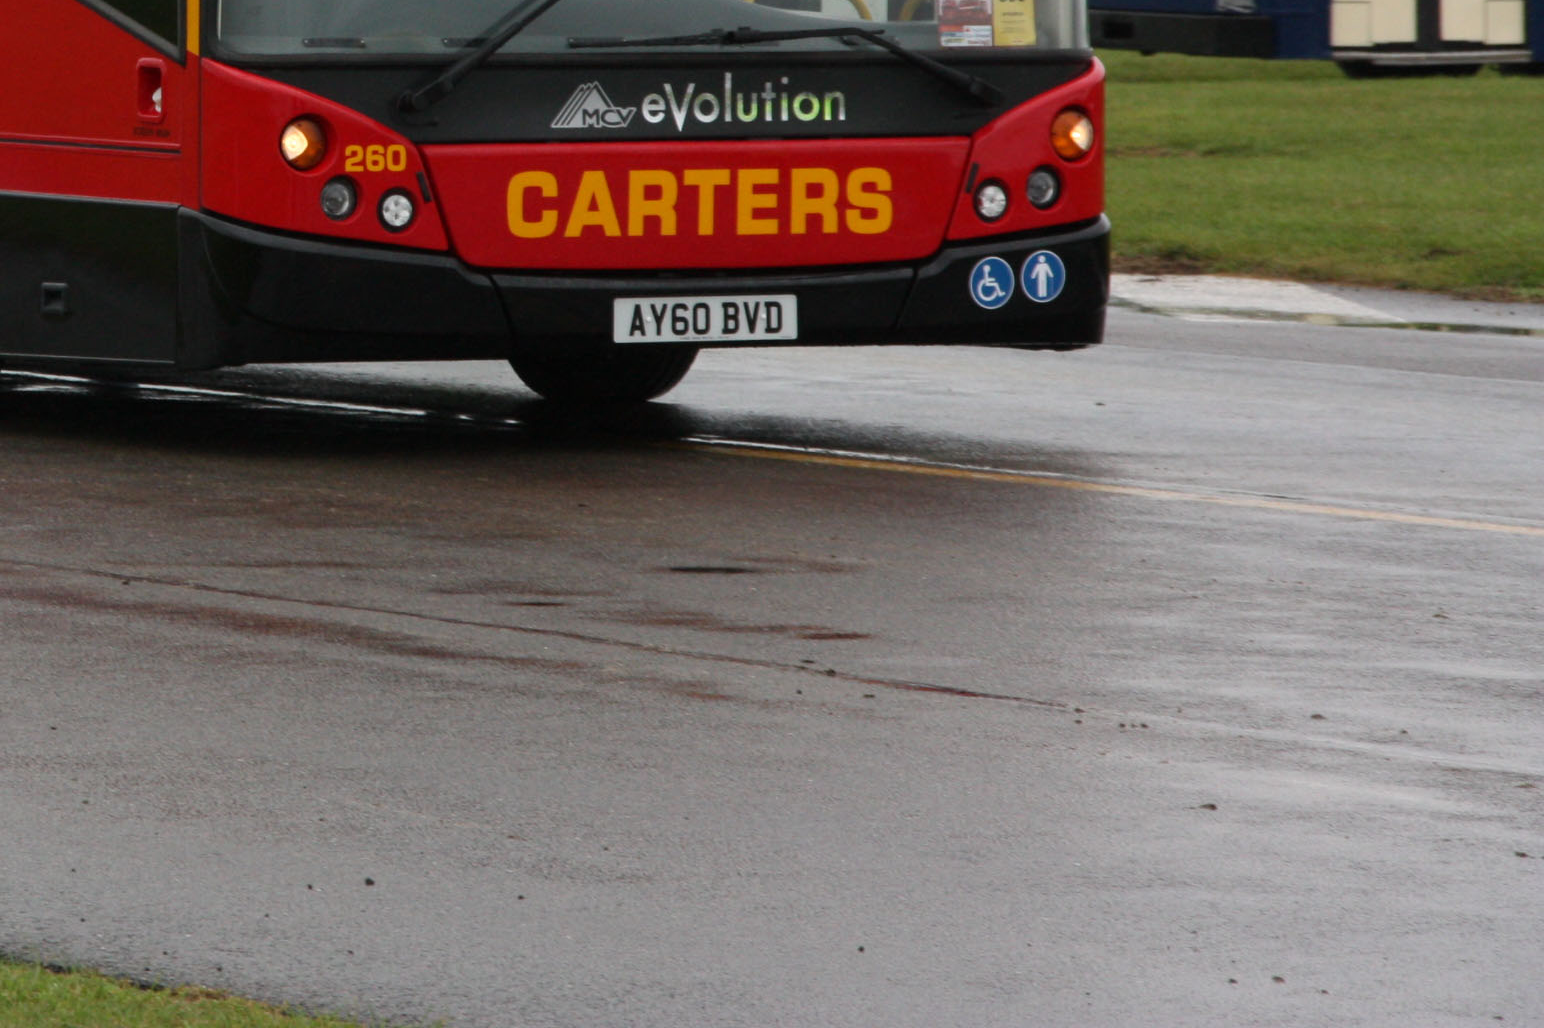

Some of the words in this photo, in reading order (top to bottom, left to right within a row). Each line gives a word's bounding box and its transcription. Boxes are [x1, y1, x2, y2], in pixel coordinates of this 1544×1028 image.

[581, 107, 637, 127] MCV
[344, 144, 407, 172] 260
[506, 167, 894, 239] CARTERS
[628, 302, 712, 337] AY60
[721, 300, 784, 334] BVD
